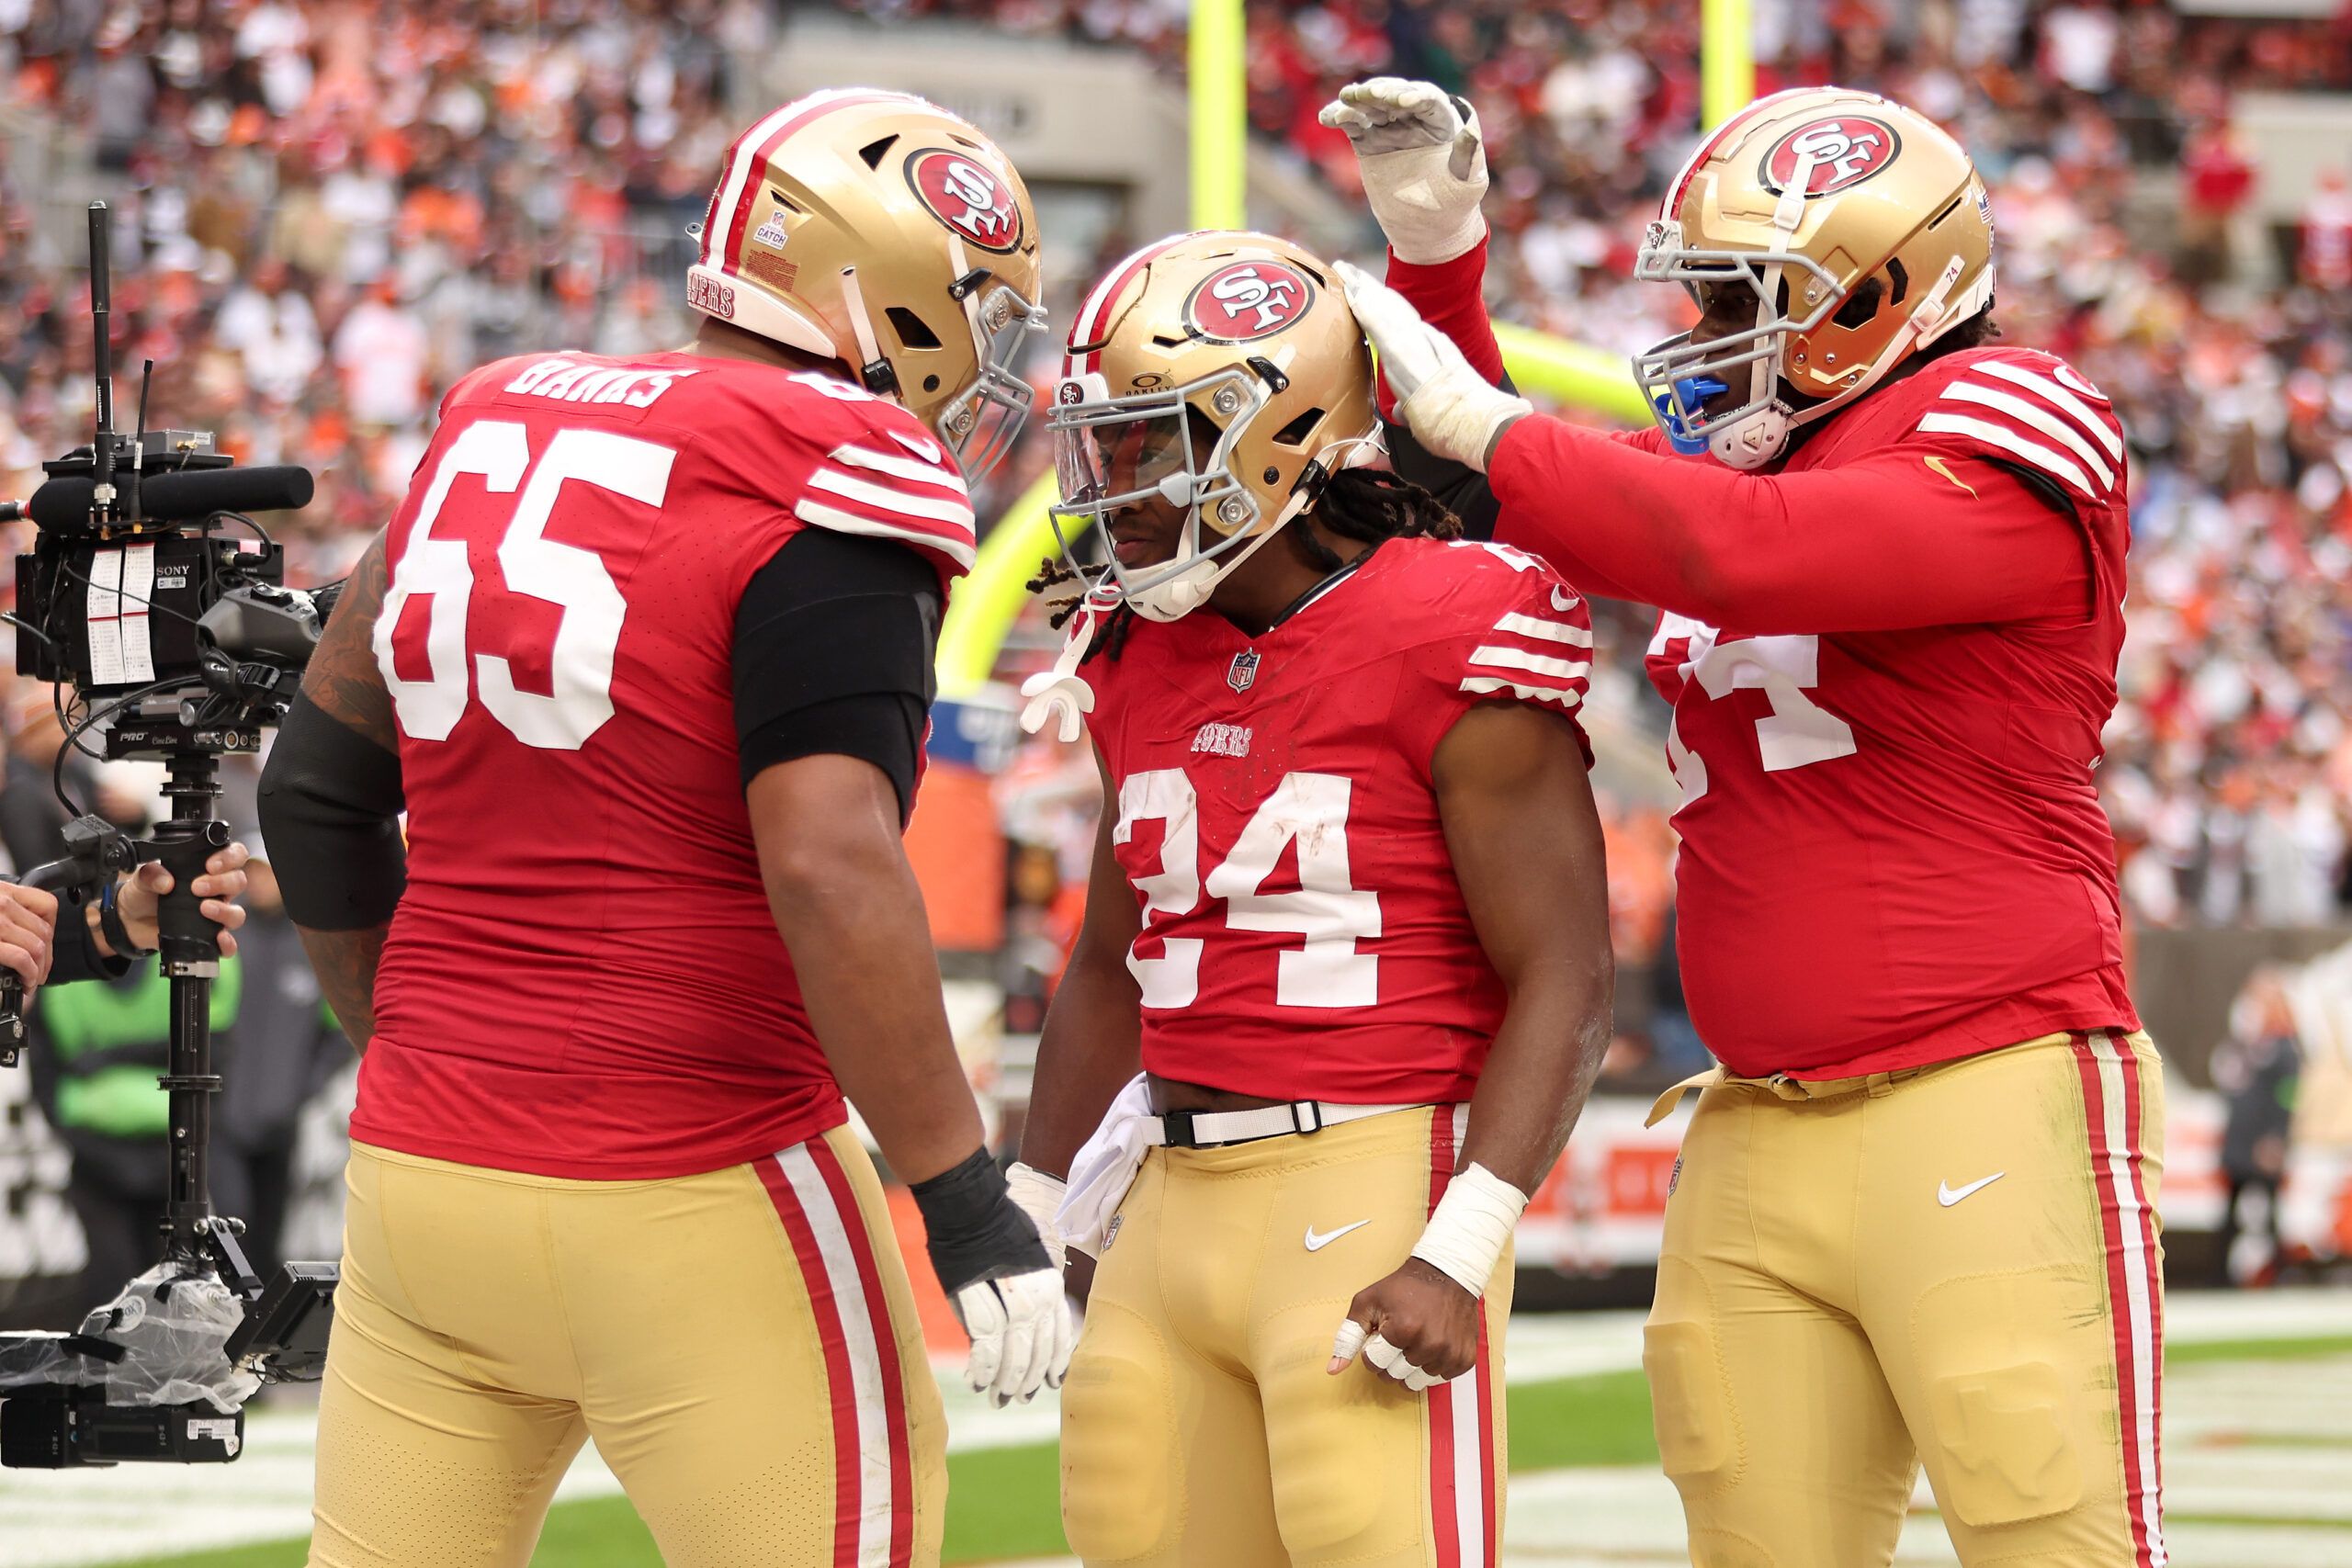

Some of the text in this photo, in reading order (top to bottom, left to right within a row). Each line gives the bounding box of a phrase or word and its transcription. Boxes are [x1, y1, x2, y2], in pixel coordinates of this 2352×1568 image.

[1790, 122, 1882, 186] SF
[944, 162, 1011, 237] SF
[757, 227, 786, 246] CATCH
[1945, 266, 1959, 283] 74
[1211, 267, 1297, 331] SF
[503, 359, 700, 409] BANKS
[1125, 386, 1170, 397] OAKLEY
[156, 566, 189, 576] SONY
[373, 420, 678, 751] 65
[1232, 667, 1250, 685] NFL
[1190, 722, 1253, 758] 49ERS
[1113, 767, 1383, 1010] 24
